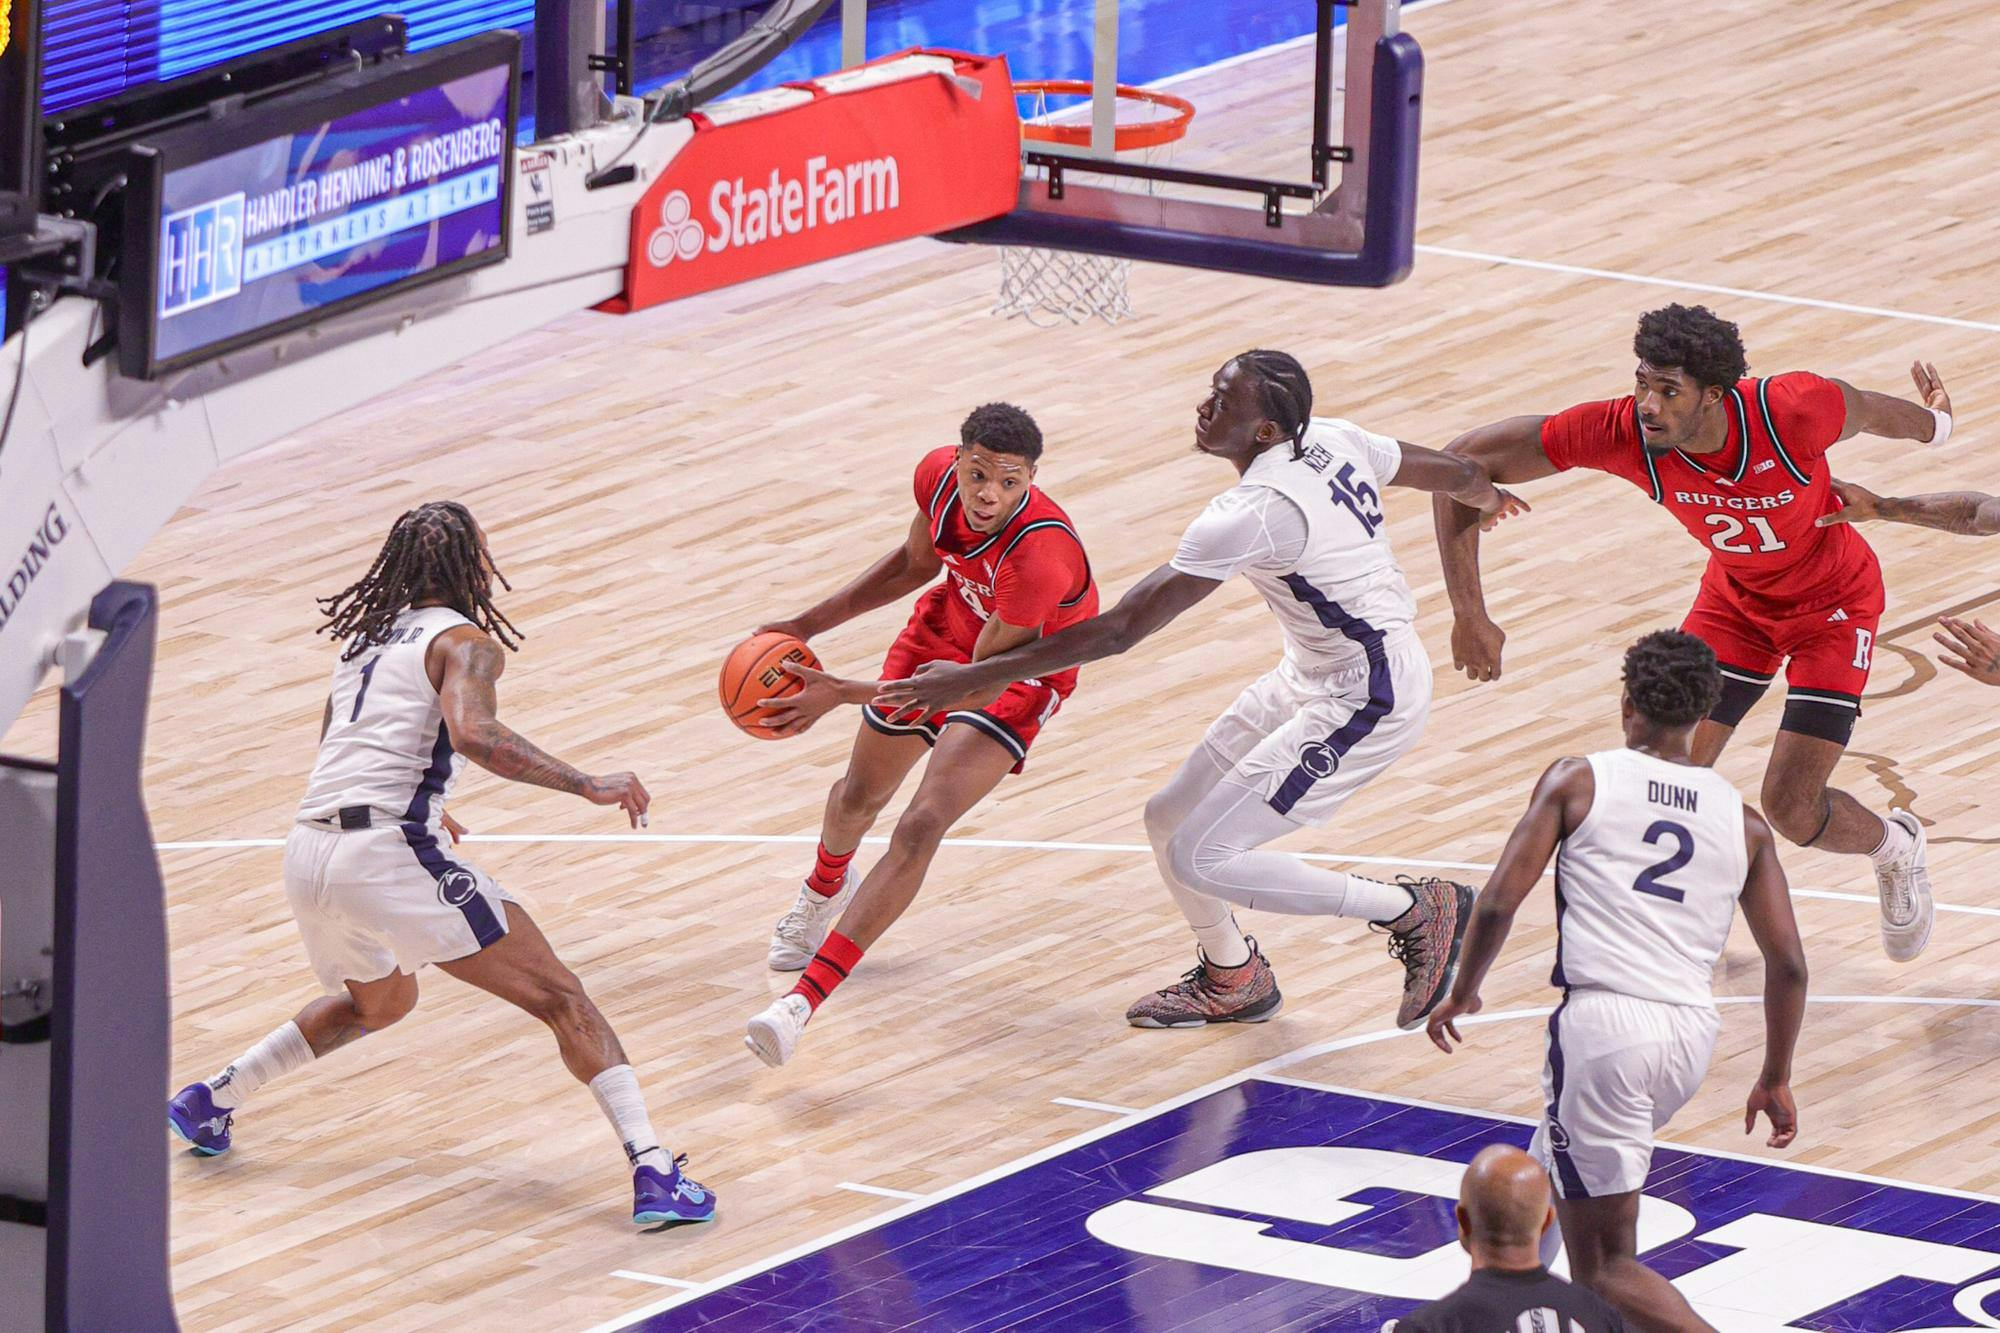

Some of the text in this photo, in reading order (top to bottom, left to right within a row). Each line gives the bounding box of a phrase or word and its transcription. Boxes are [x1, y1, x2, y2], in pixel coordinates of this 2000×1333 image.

[246, 117, 501, 238] HANDLER HENNING & ROSENBERG
[168, 215, 237, 298] HHR
[252, 173, 491, 271] ATTORNEYS AT LAW
[1327, 462, 1384, 539] 15
[1674, 489, 1795, 511] RUTGERS
[1703, 513, 1787, 554] 21
[0, 501, 68, 632] LDING
[1852, 626, 1873, 672] R
[350, 654, 381, 722] 1
[1647, 780, 1698, 813] DUNN
[1632, 820, 1695, 904] 2
